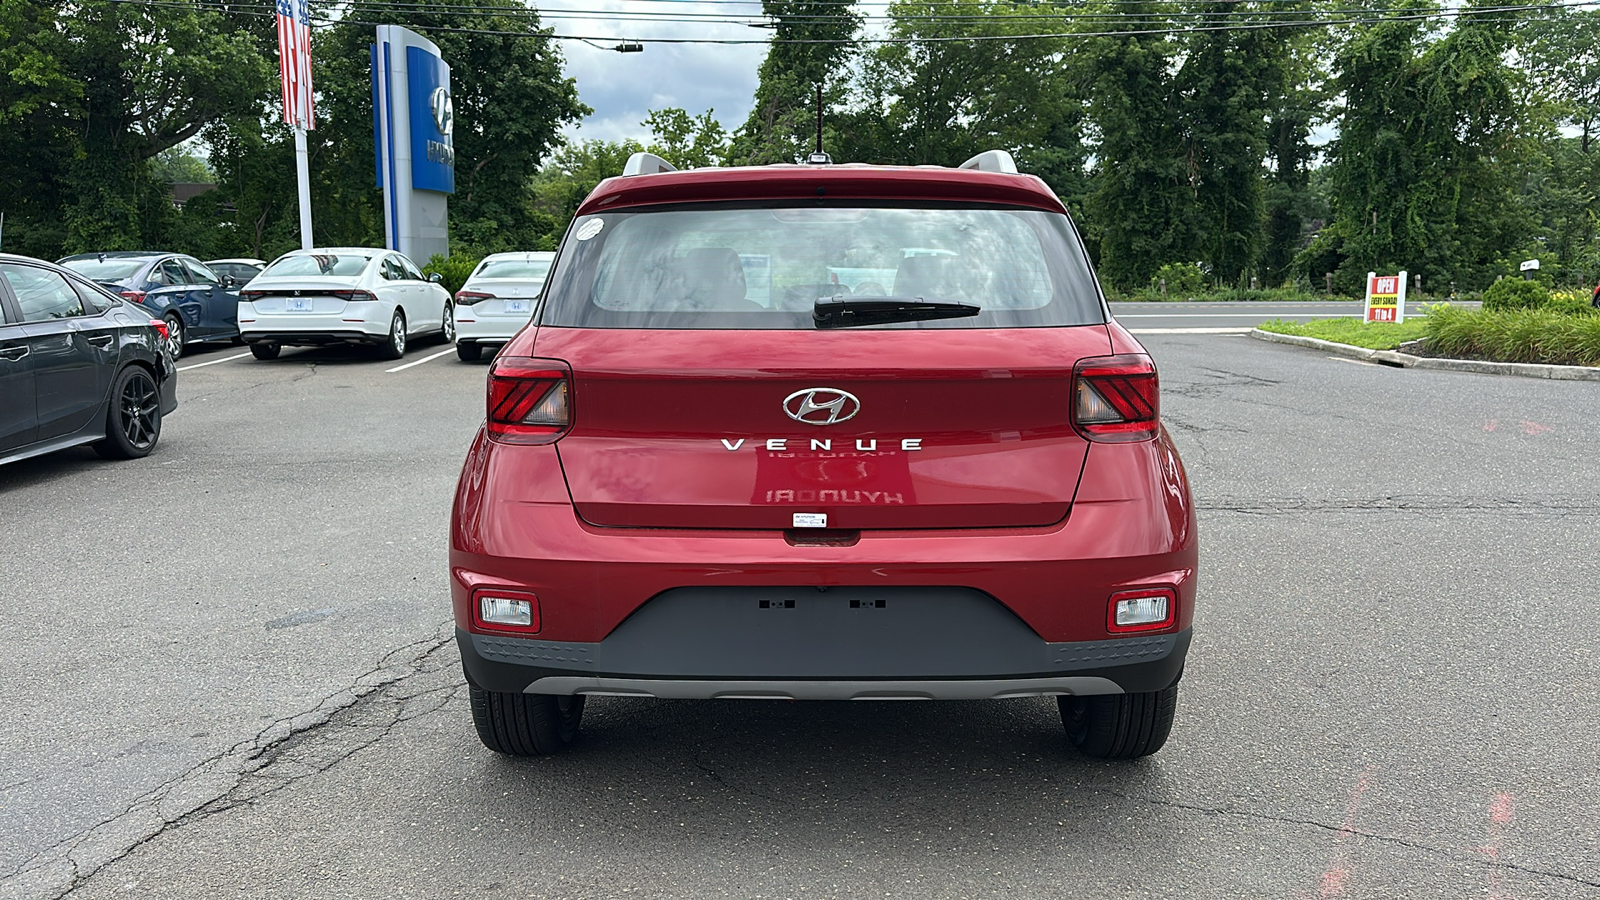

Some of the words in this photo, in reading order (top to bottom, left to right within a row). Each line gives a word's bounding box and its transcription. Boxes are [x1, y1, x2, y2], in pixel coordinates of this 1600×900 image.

[427, 139, 455, 166] HYUND
[1377, 278, 1395, 293] OPEN
[1371, 297, 1382, 305] EVERY
[1375, 308, 1380, 320] 11
[1381, 308, 1387, 320] to
[1387, 308, 1392, 320] 4
[721, 438, 923, 451] VENUE
